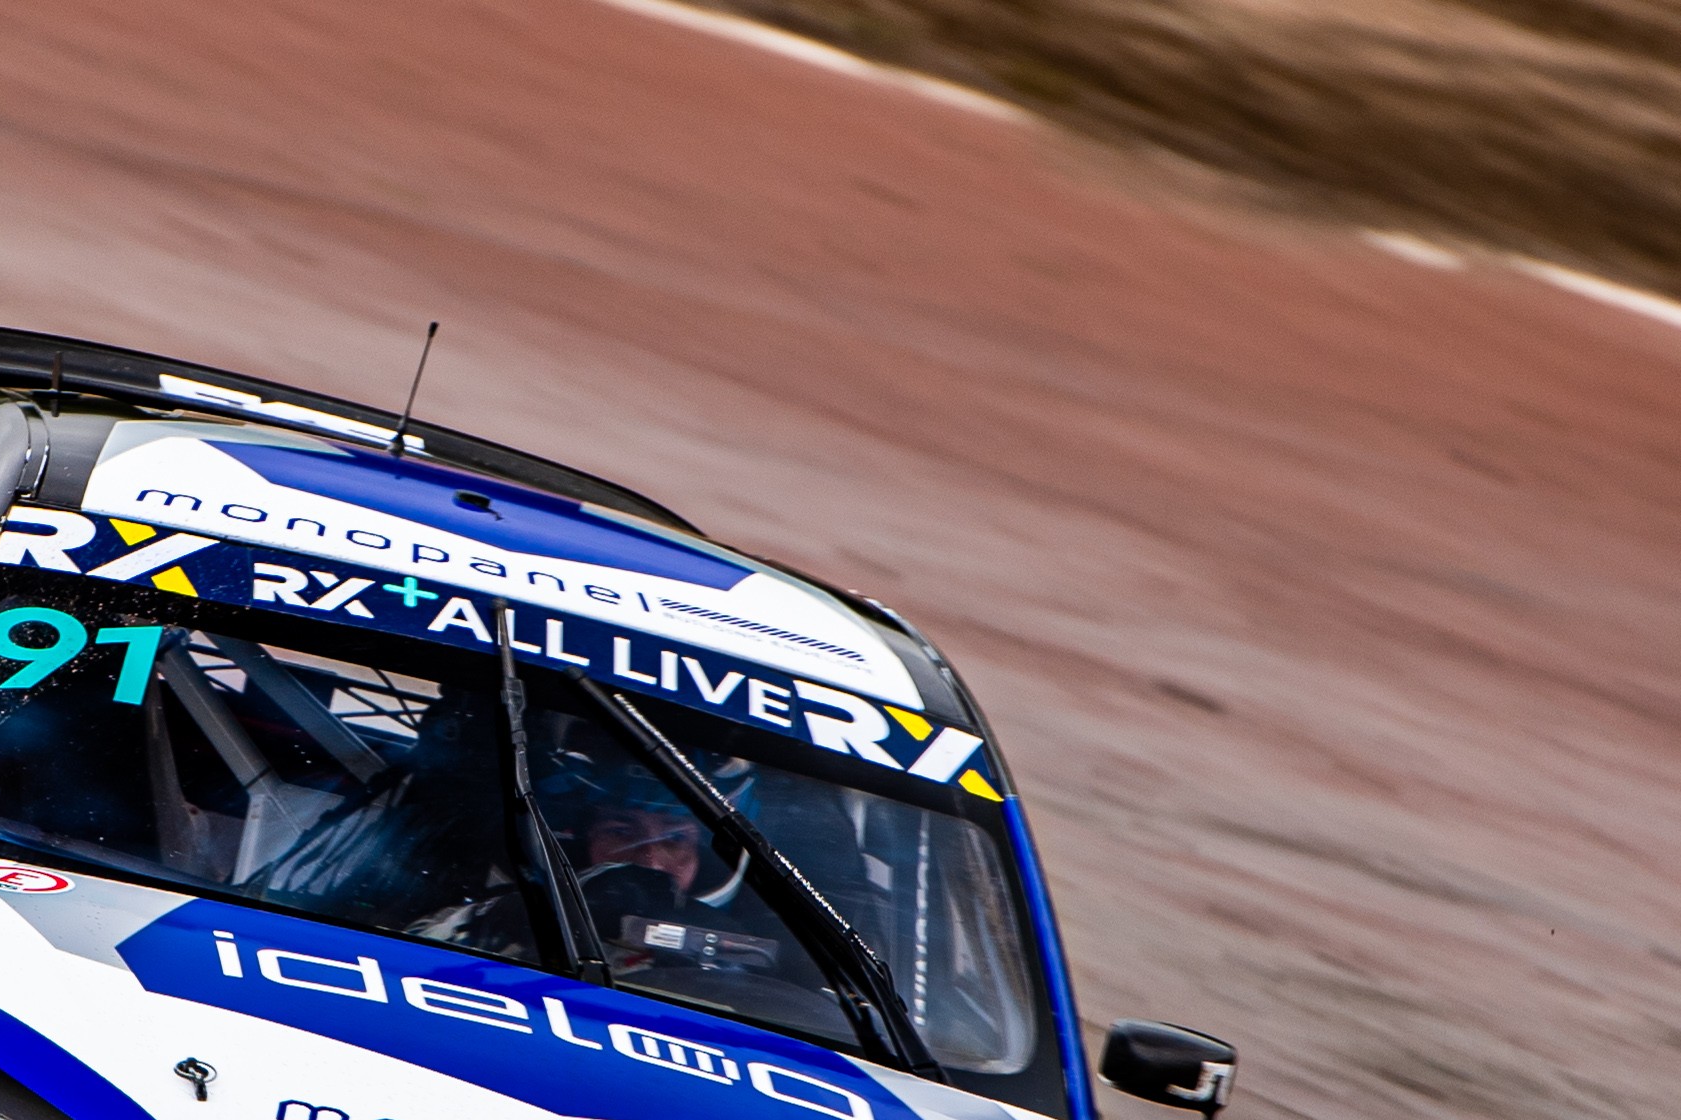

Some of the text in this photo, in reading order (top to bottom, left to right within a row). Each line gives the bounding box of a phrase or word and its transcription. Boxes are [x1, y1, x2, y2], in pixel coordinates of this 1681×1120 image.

[136, 488, 650, 612] monopanel
[427, 596, 590, 667] ALL
[613, 636, 793, 729] LIVE
[793, 679, 1006, 802] RX
